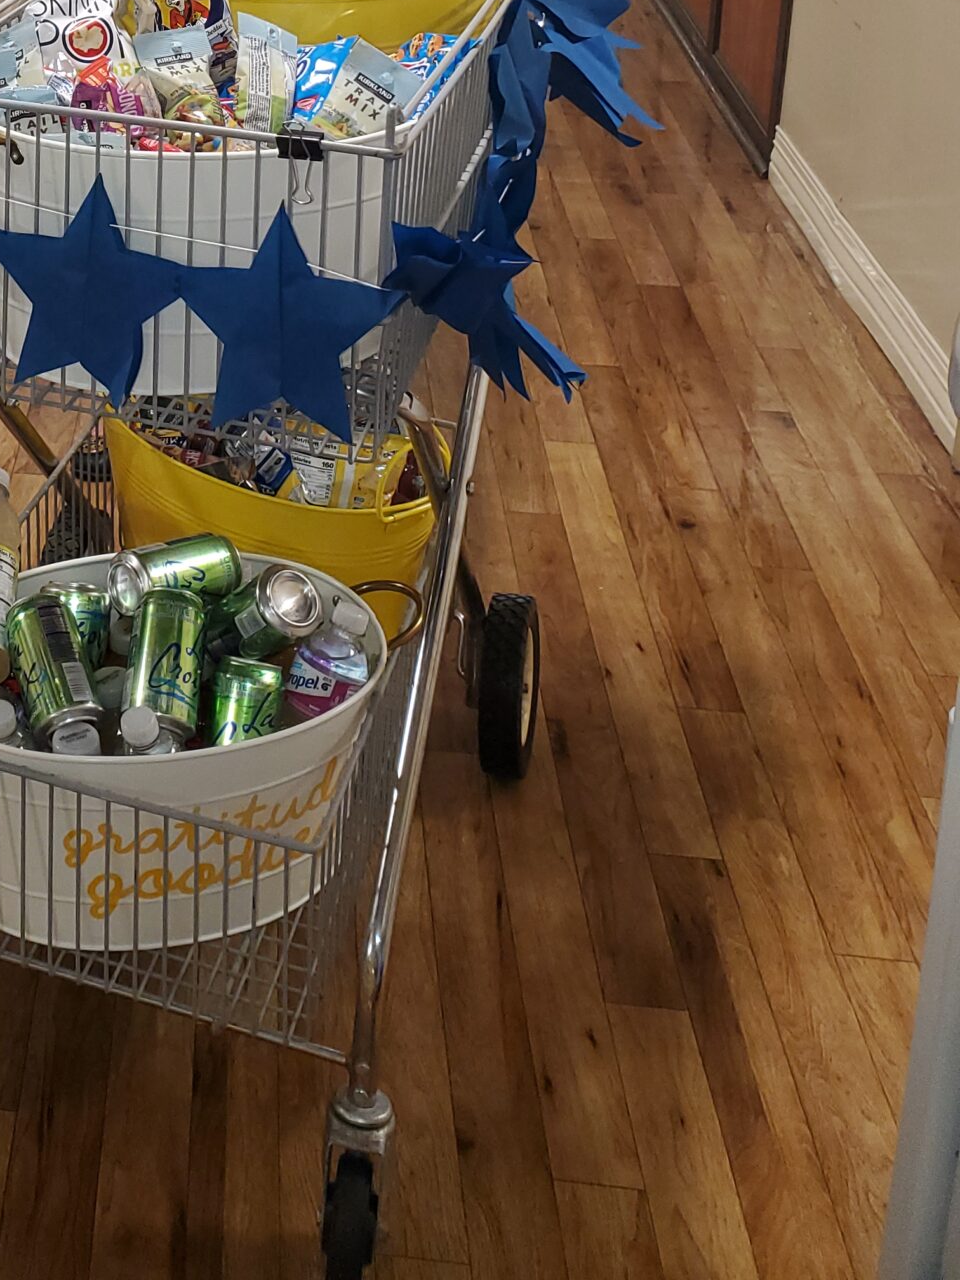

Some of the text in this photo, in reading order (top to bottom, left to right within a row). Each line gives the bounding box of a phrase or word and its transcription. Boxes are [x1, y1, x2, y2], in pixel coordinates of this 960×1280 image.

[156, 53, 191, 64] KIRKLAND
[169, 65, 204, 77] MIX
[343, 78, 386, 111] TRAI
[357, 74, 393, 100] KIRKLAND
[344, 93, 381, 121] MIX
[13, 114, 59, 132] RAIL
[322, 460, 335, 469] 160
